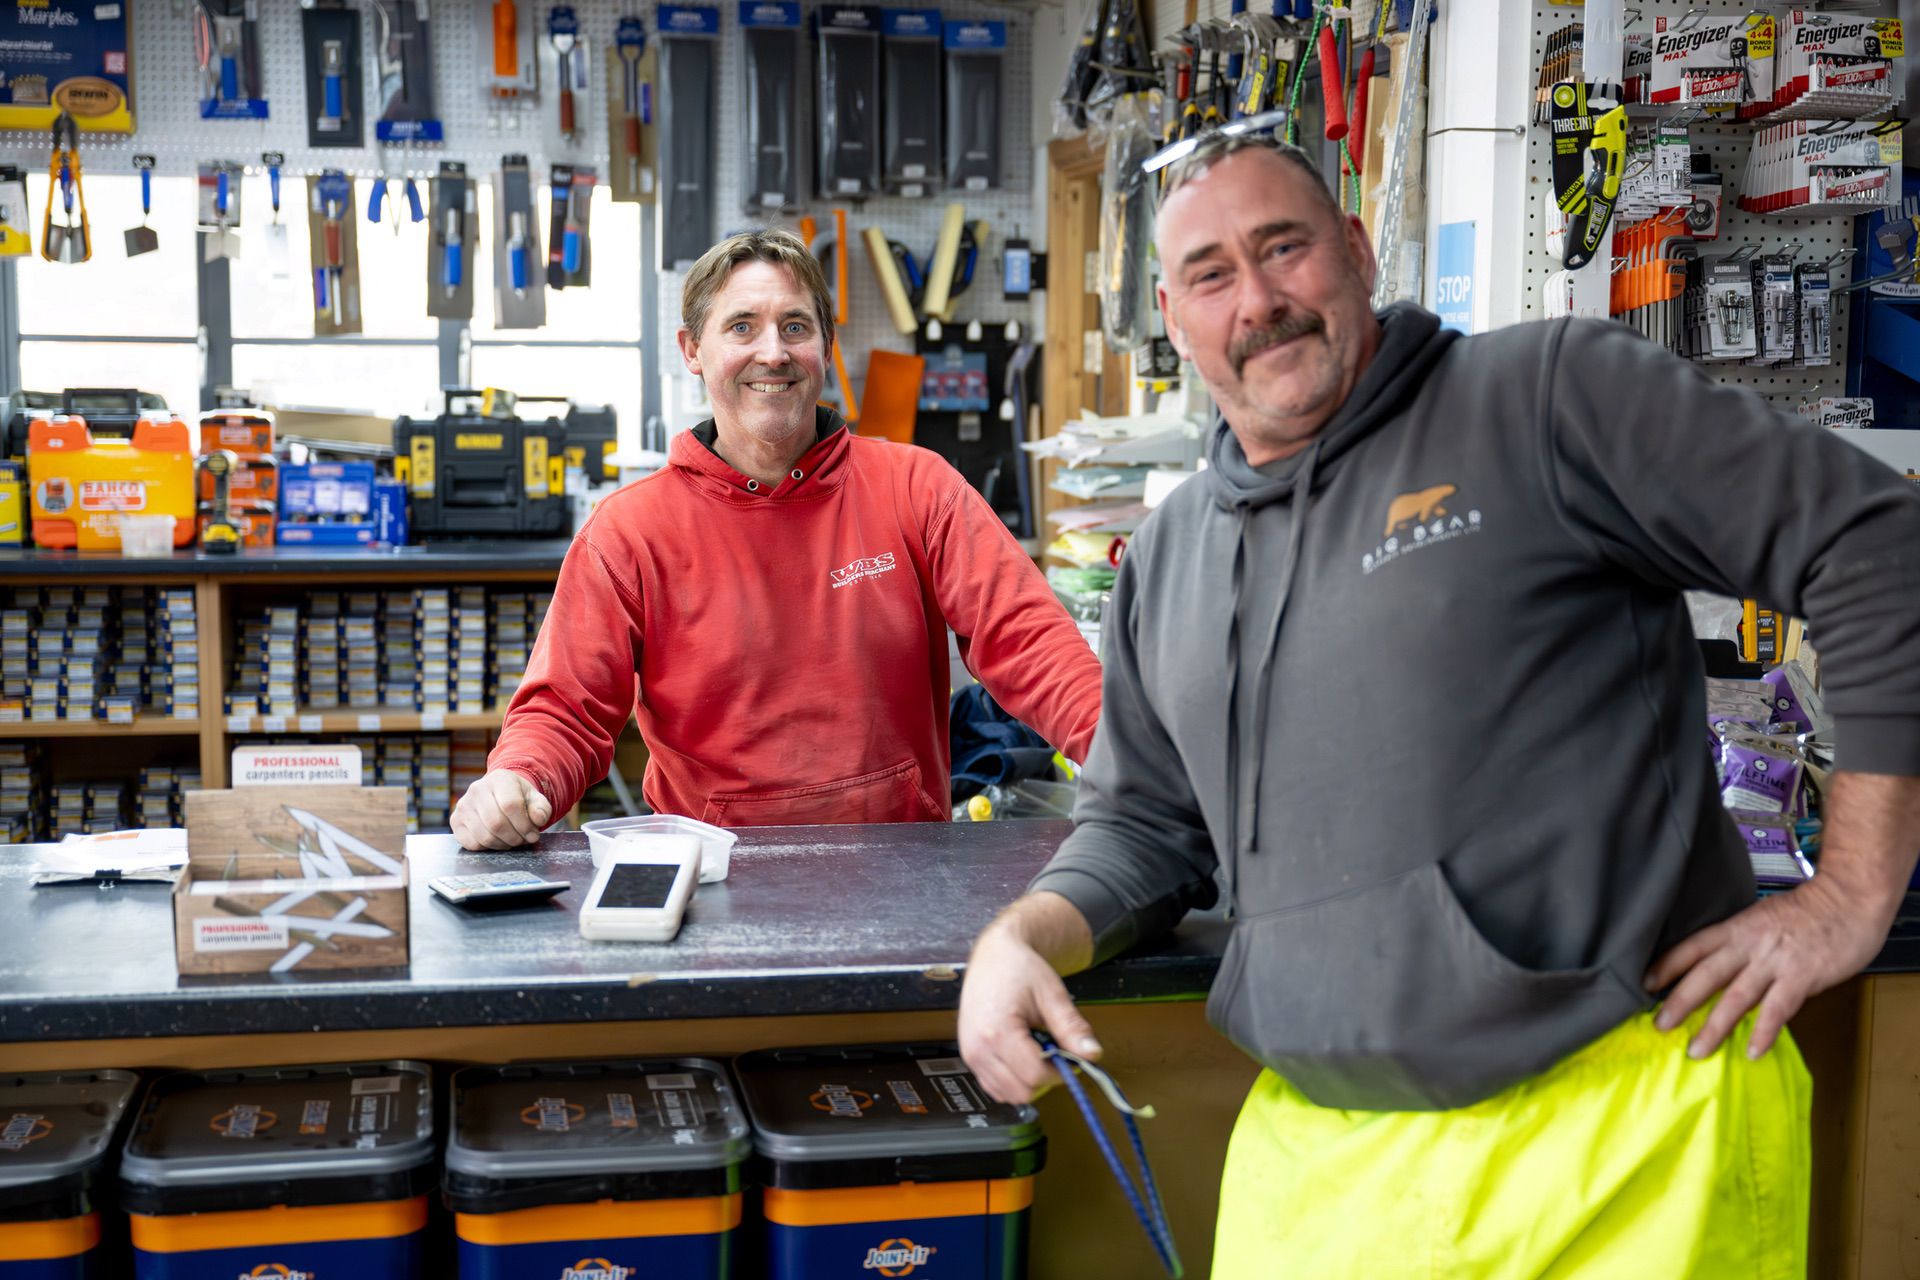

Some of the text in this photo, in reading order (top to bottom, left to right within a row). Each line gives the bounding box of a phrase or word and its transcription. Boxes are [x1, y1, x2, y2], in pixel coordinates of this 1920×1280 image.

[1750, 26, 1772, 39] 4+4
[1795, 23, 1864, 46] Energizer
[1881, 29, 1902, 40] 4+4
[1656, 24, 1733, 55] Energizer
[1803, 43, 1825, 52] MAX
[1663, 51, 1688, 62] MAX
[1797, 130, 1865, 156] Energizer
[1804, 152, 1826, 163] MAX
[1714, 265, 1740, 273] DURUM
[1766, 264, 1791, 272] DURUM
[1438, 275, 1471, 304] STOP
[1823, 407, 1872, 426] Energizer
[830, 552, 895, 582] WBS
[865, 563, 896, 577] MERCHANT
[832, 571, 864, 589] BUILDERS
[254, 757, 340, 768] PROFESSIONAL
[246, 766, 349, 781] carpenters pencils
[201, 924, 270, 934] PROFESSIONAL
[201, 931, 283, 944] carpenters pencils
